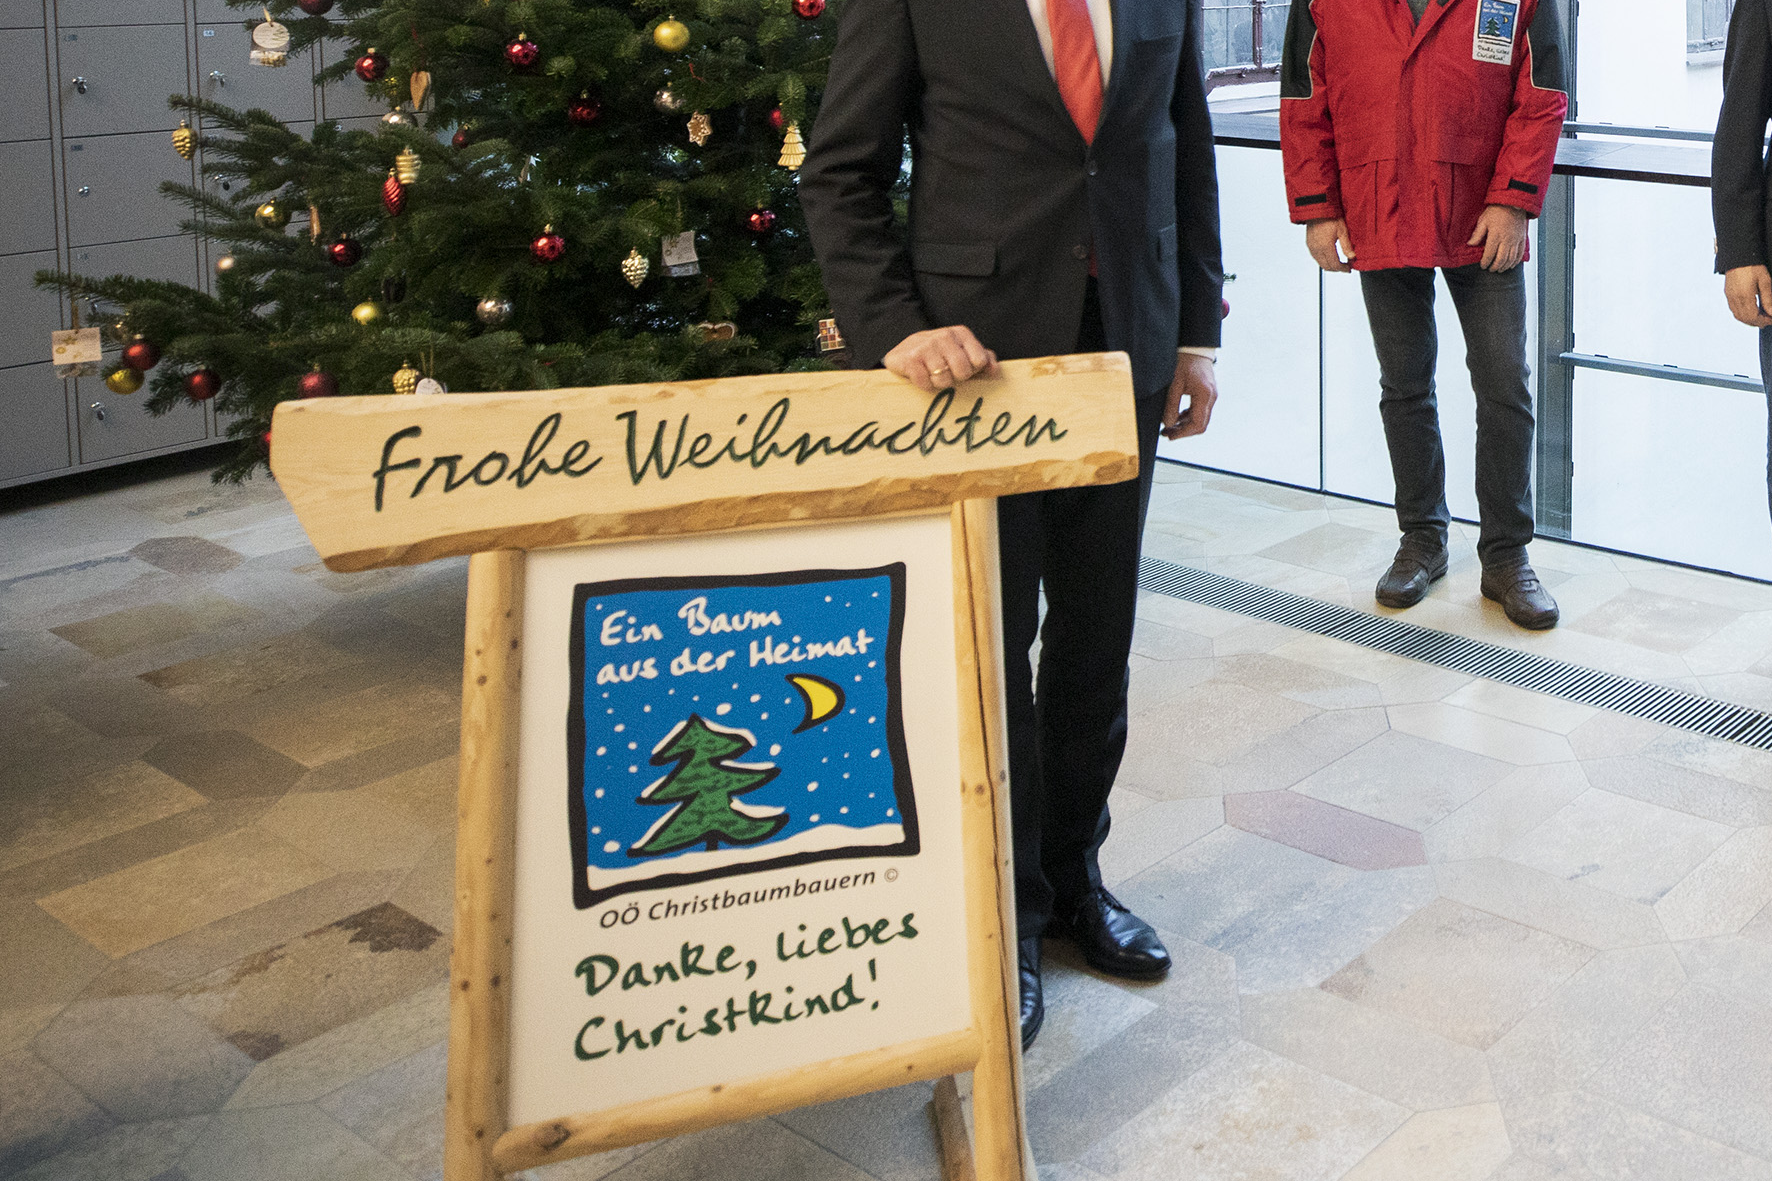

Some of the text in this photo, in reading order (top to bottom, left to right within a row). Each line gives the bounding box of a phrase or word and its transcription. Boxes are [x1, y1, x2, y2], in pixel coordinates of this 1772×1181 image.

[373, 388, 1068, 511] Frohe Weihnachten
[599, 597, 782, 647] Ein Baum
[596, 628, 874, 686] aus der Heimat
[599, 901, 641, 928] OÖ
[648, 871, 877, 921] Christbaumbauern
[574, 941, 757, 997] Danke,
[573, 958, 880, 1061] Christkind!
